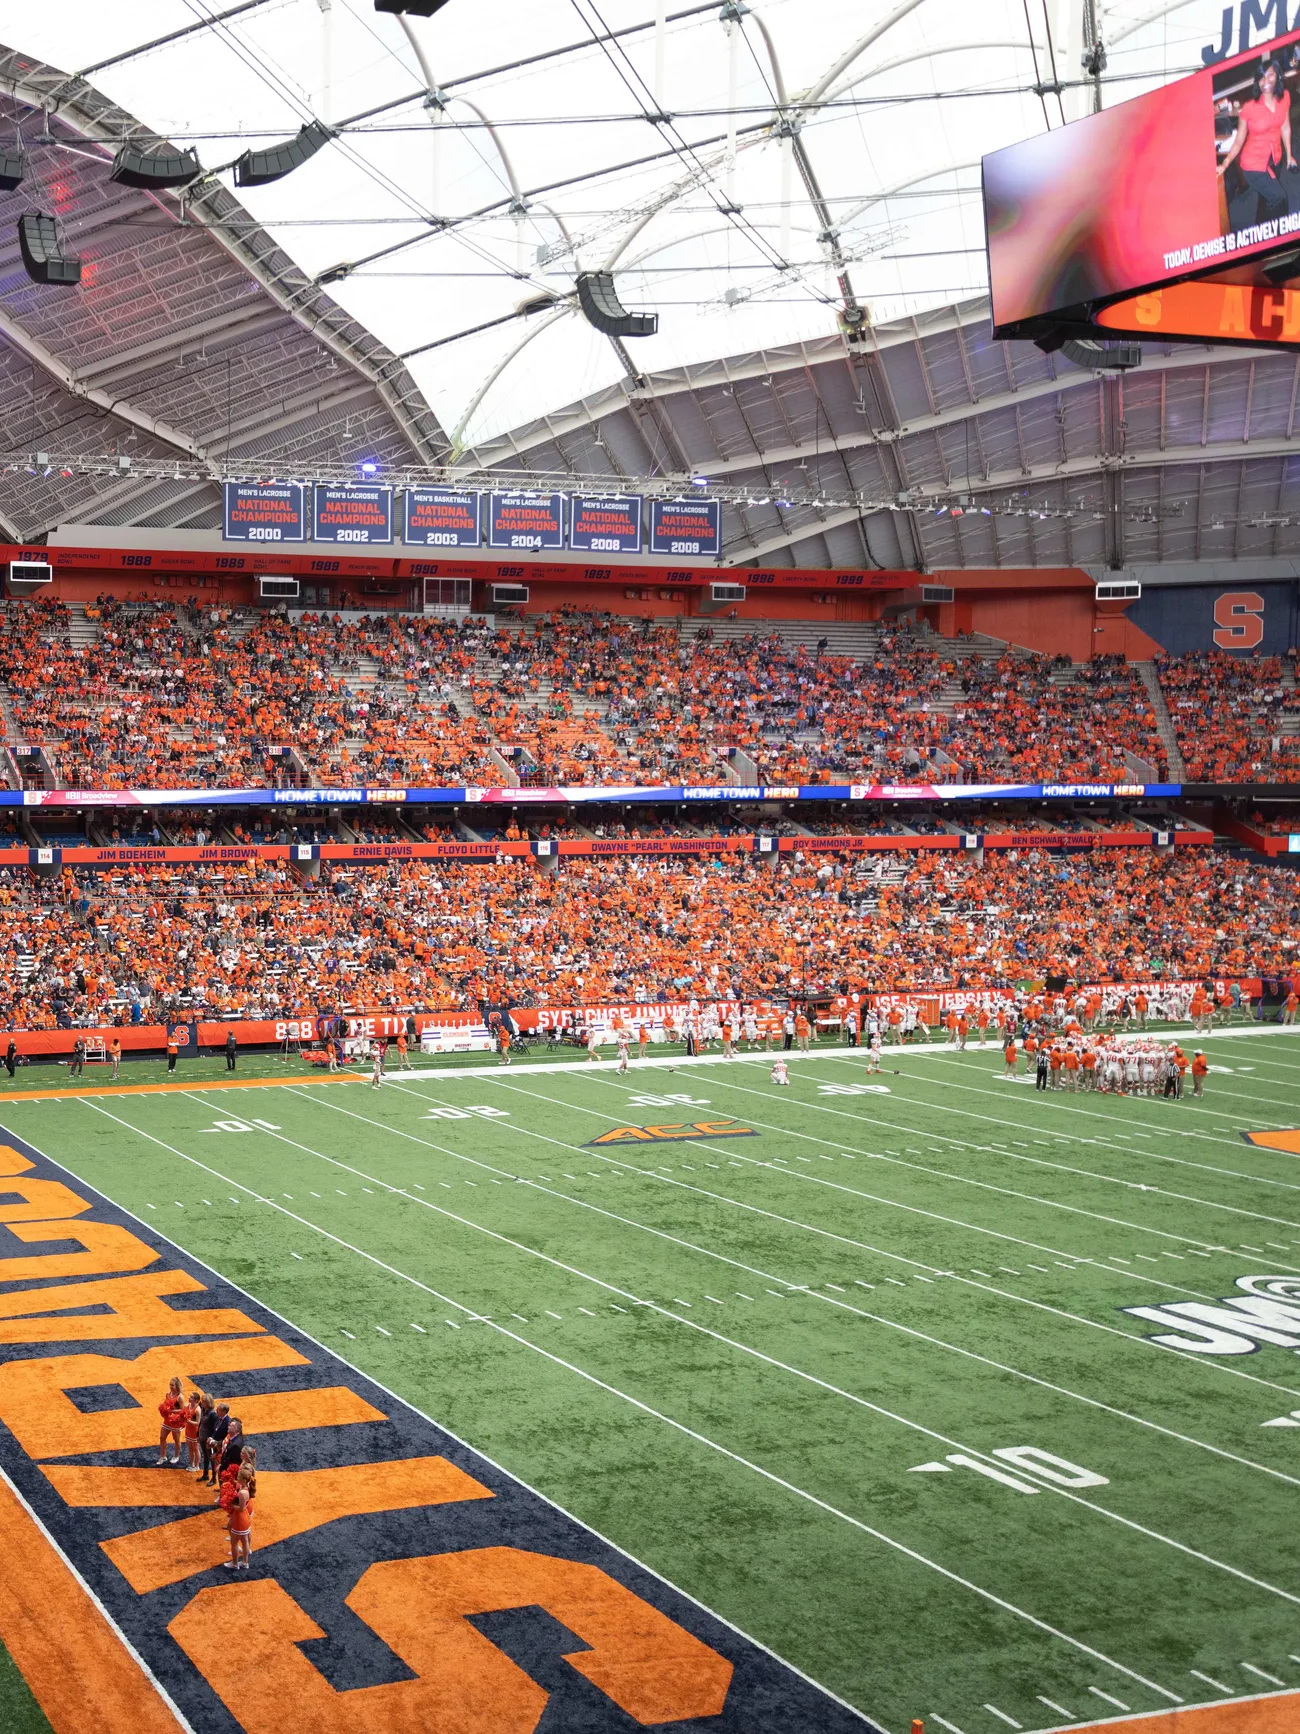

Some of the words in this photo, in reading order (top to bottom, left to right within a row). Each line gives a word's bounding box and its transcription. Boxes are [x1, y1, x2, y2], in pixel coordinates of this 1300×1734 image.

[1164, 249, 1193, 269] TODAY,
[1193, 236, 1226, 261] DENISE
[1226, 234, 1236, 252] IS
[1237, 219, 1279, 248] ACTIVELY
[238, 489, 257, 497] MEN'S
[259, 489, 291, 498] LACROSSE
[348, 492, 379, 500] LACROSSE
[434, 495, 472, 504] BASKETBALL
[521, 499, 551, 507] LACROSSE
[237, 499, 292, 512] NATIONAL
[326, 502, 380, 513] NATIONAL
[416, 505, 469, 517] NATIONAL
[601, 502, 630, 510] LACROSSE
[680, 506, 709, 514] LACROSSE
[231, 511, 298, 523] CHAMPIONS
[320, 513, 386, 526] CHAMPIONS
[501, 509, 552, 520] NATIONAL
[582, 512, 631, 524] NATIONAL
[411, 517, 474, 529] CHAMPIONS
[495, 520, 557, 531] CHAMPIONS
[662, 516, 710, 527] NATIONAL
[248, 528, 281, 540] 2000
[576, 524, 635, 535] CHAMPIONS
[656, 526, 714, 538] CHAMPIONS
[337, 529, 369, 542] 2002
[427, 533, 457, 546] 2003
[511, 535, 542, 548] 2004
[591, 538, 620, 550] 2008
[671, 541, 699, 553] 2009
[58, 553, 101, 561] INDEPENDENCE
[121, 555, 152, 566] 1988
[215, 558, 245, 569] 1989
[310, 561, 340, 573] 1989
[409, 564, 438, 575] 1990
[496, 567, 524, 577] 1992
[584, 569, 611, 580] 1993
[666, 572, 692, 582] 1996
[747, 574, 775, 584] 1996
[836, 575, 863, 585] 1999
[1213, 591, 1265, 649] S
[81, 792, 119, 800] Broadview
[275, 790, 362, 802] HOMETOWN
[366, 790, 407, 801] HERO
[683, 787, 760, 799] HOMETOWN
[764, 787, 799, 799] HERO
[1043, 785, 1110, 796] HOMETOWN
[1114, 785, 1145, 795] HERO
[438, 846, 467, 854] FLOYD
[469, 845, 500, 854] LITTLE
[592, 843, 629, 852] DWAYNE
[669, 841, 728, 850] WASHINGTON
[793, 841, 809, 849] ROY
[811, 839, 851, 848] SIMMONS
[852, 839, 865, 847] JR.
[97, 851, 116, 860] JIM
[119, 850, 166, 860] BOEHEIM
[199, 849, 218, 858] JIM
[220, 849, 258, 858] BROWN
[353, 847, 383, 857] ERNIE
[385, 846, 412, 856] DAVIS
[1126, 1056, 1137, 1064] 77
[1144, 1057, 1155, 1065] 56
[593, 1119, 754, 1144] ACC
[945, 1446, 1111, 1494] 10
